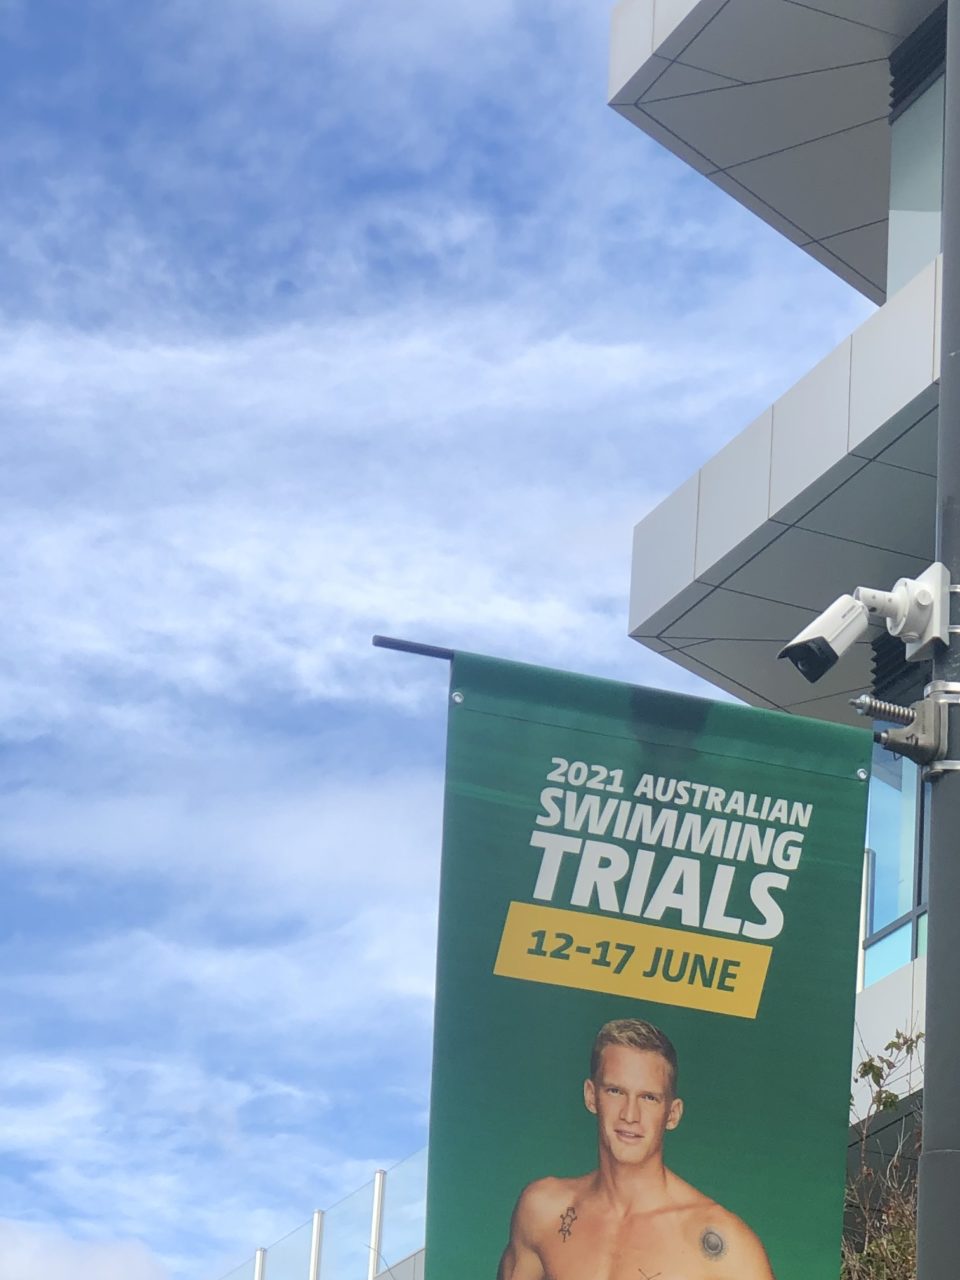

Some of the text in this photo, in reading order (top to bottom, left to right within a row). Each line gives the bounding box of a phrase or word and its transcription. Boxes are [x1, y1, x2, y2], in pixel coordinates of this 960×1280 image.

[535, 787, 804, 870] SWIMMING
[547, 757, 813, 828] 2021 AUSTRALIAN
[529, 830, 790, 940] TRIALS
[527, 929, 741, 992] 12-17 JUNE
